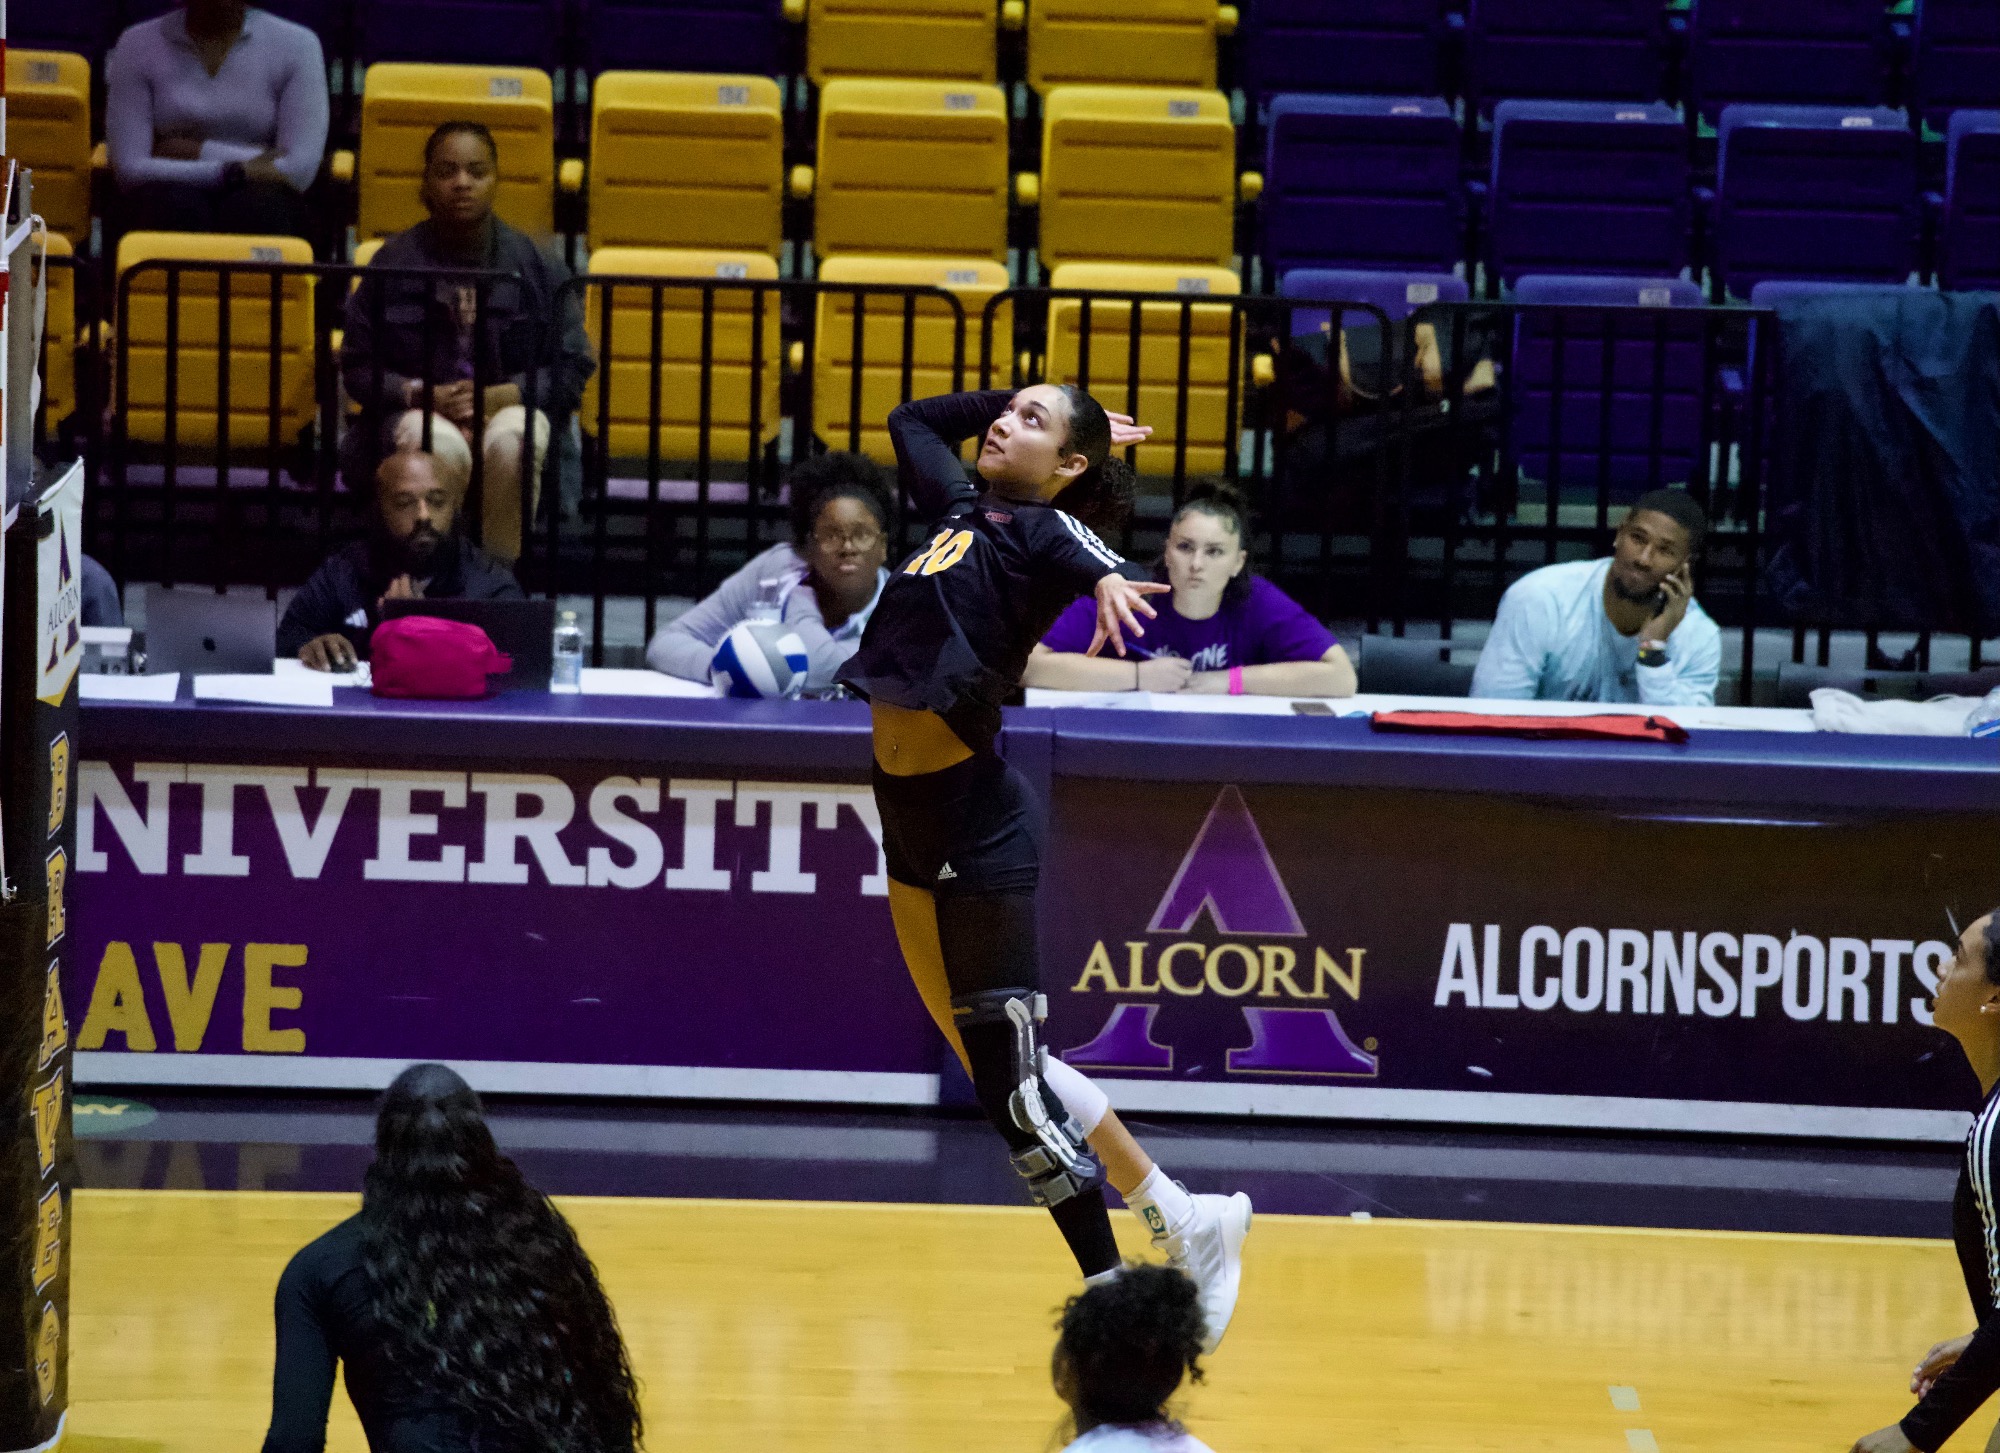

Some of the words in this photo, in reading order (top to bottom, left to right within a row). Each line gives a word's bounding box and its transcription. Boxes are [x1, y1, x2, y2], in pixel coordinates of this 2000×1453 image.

[903, 528, 975, 576] 10
[47, 580, 79, 635] ALCORN
[76, 941, 309, 1053] AVE
[1071, 940, 1366, 1000] ALCORN
[1435, 923, 1955, 1026] ALCORNSPORTS
[31, 731, 70, 1406] BRAVES
